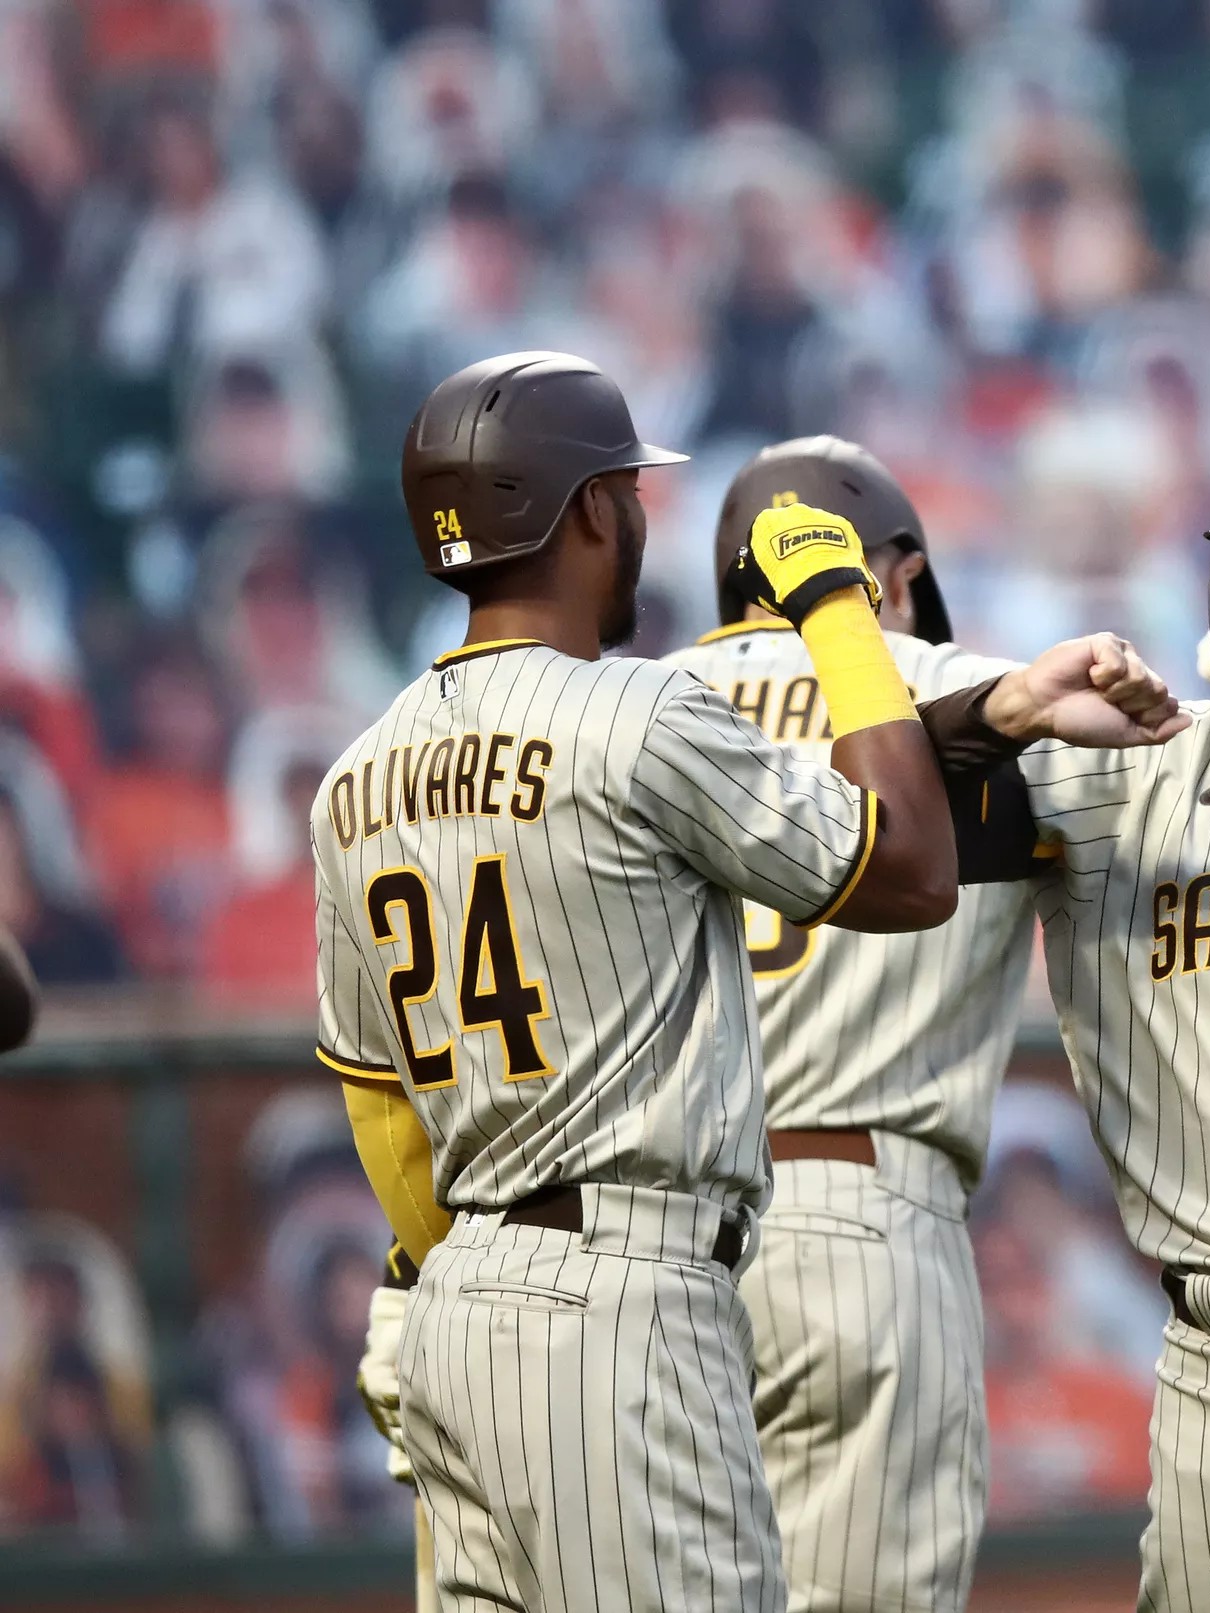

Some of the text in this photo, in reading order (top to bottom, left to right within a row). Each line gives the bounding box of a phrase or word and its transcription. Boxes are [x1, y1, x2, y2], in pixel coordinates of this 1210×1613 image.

[433, 508, 462, 541] 24
[778, 529, 843, 556] Franklin
[329, 733, 554, 852] OLIVARES
[365, 852, 559, 1092] 24
